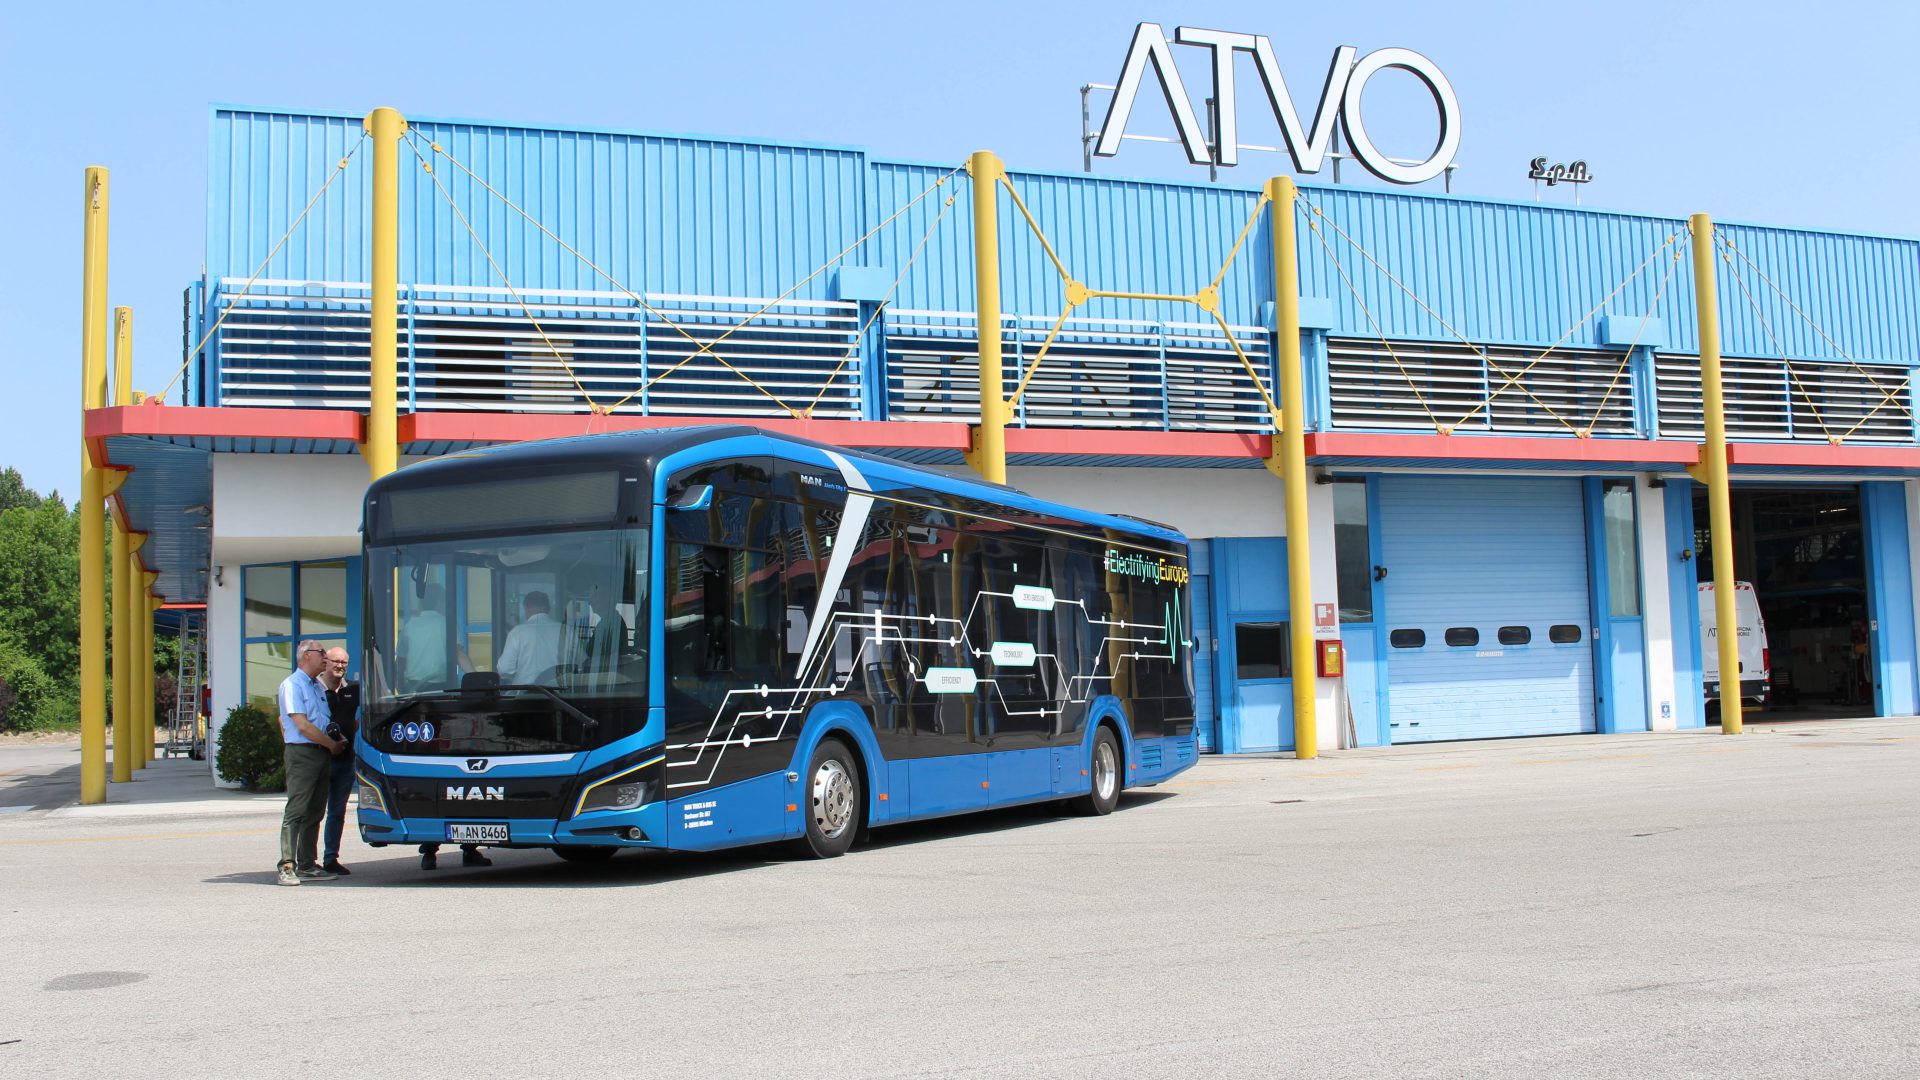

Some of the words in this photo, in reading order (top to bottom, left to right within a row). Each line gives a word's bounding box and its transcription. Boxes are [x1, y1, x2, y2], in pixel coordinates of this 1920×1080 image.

[1094, 21, 1462, 185] ATVO
[800, 474, 822, 487] MAN
[941, 676, 962, 685] EFFICIENCY
[446, 786, 505, 801] MAN
[452, 826, 459, 838] M
[466, 827, 479, 839] AN
[480, 827, 507, 839] 8466
